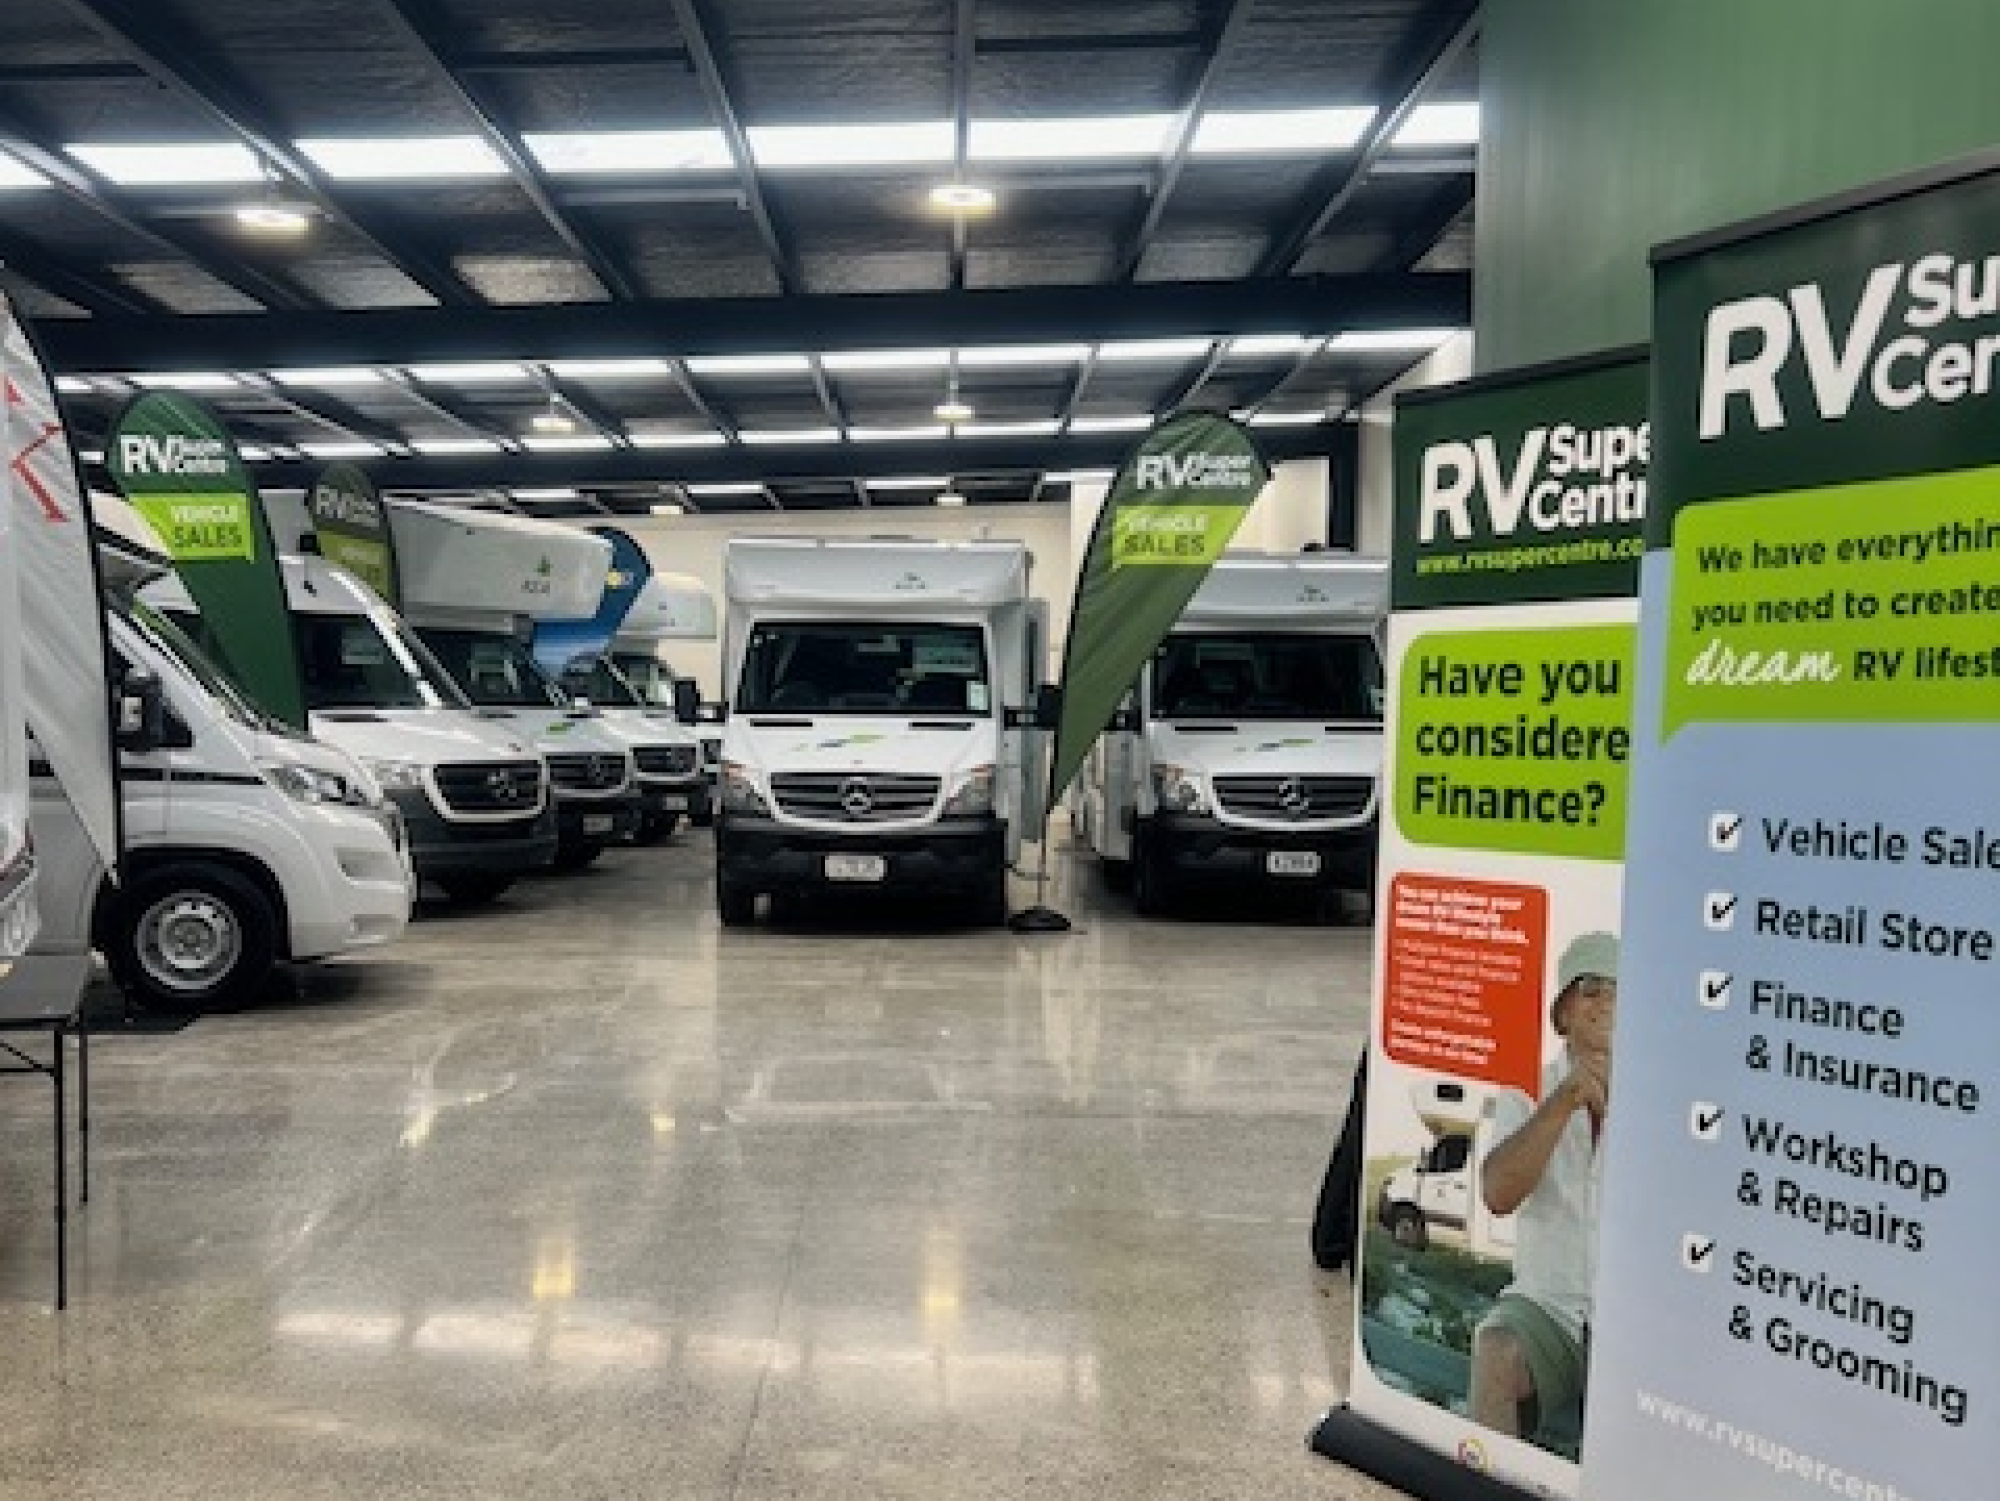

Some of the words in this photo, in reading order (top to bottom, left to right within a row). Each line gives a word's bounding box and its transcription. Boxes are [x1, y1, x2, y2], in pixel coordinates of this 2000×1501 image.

[1700, 262, 1904, 440] RV
[120, 434, 184, 474] RV
[1136, 452, 1204, 489] RV
[1419, 429, 1548, 544] RV
[174, 526, 243, 547] SALES
[1123, 534, 1206, 556] SALES
[1697, 543, 1743, 573] We
[1752, 538, 1827, 569] have
[1691, 604, 1748, 635] you
[1754, 589, 1834, 623] need
[1844, 589, 1880, 620] to
[1419, 655, 1526, 697] Have
[1537, 659, 1622, 706] you
[1684, 638, 1842, 686] dream
[1853, 650, 1905, 682] RV
[1416, 713, 1631, 763] considere
[1412, 773, 1608, 827] Finance?
[1761, 817, 1909, 864] Vehicle
[1754, 897, 1867, 947] Retail
[1879, 911, 1993, 961] Store
[1749, 980, 1904, 1039] Finance
[1745, 1034, 1771, 1072] &
[1783, 1039, 1980, 1114] Insurance
[1741, 1113, 1950, 1202] Workshop
[1737, 1168, 1763, 1206] &
[1774, 1176, 1924, 1252] Repairs
[1733, 1247, 1914, 1345] Servicing
[1729, 1304, 1754, 1343] &
[1766, 1317, 1968, 1427] Grooming
